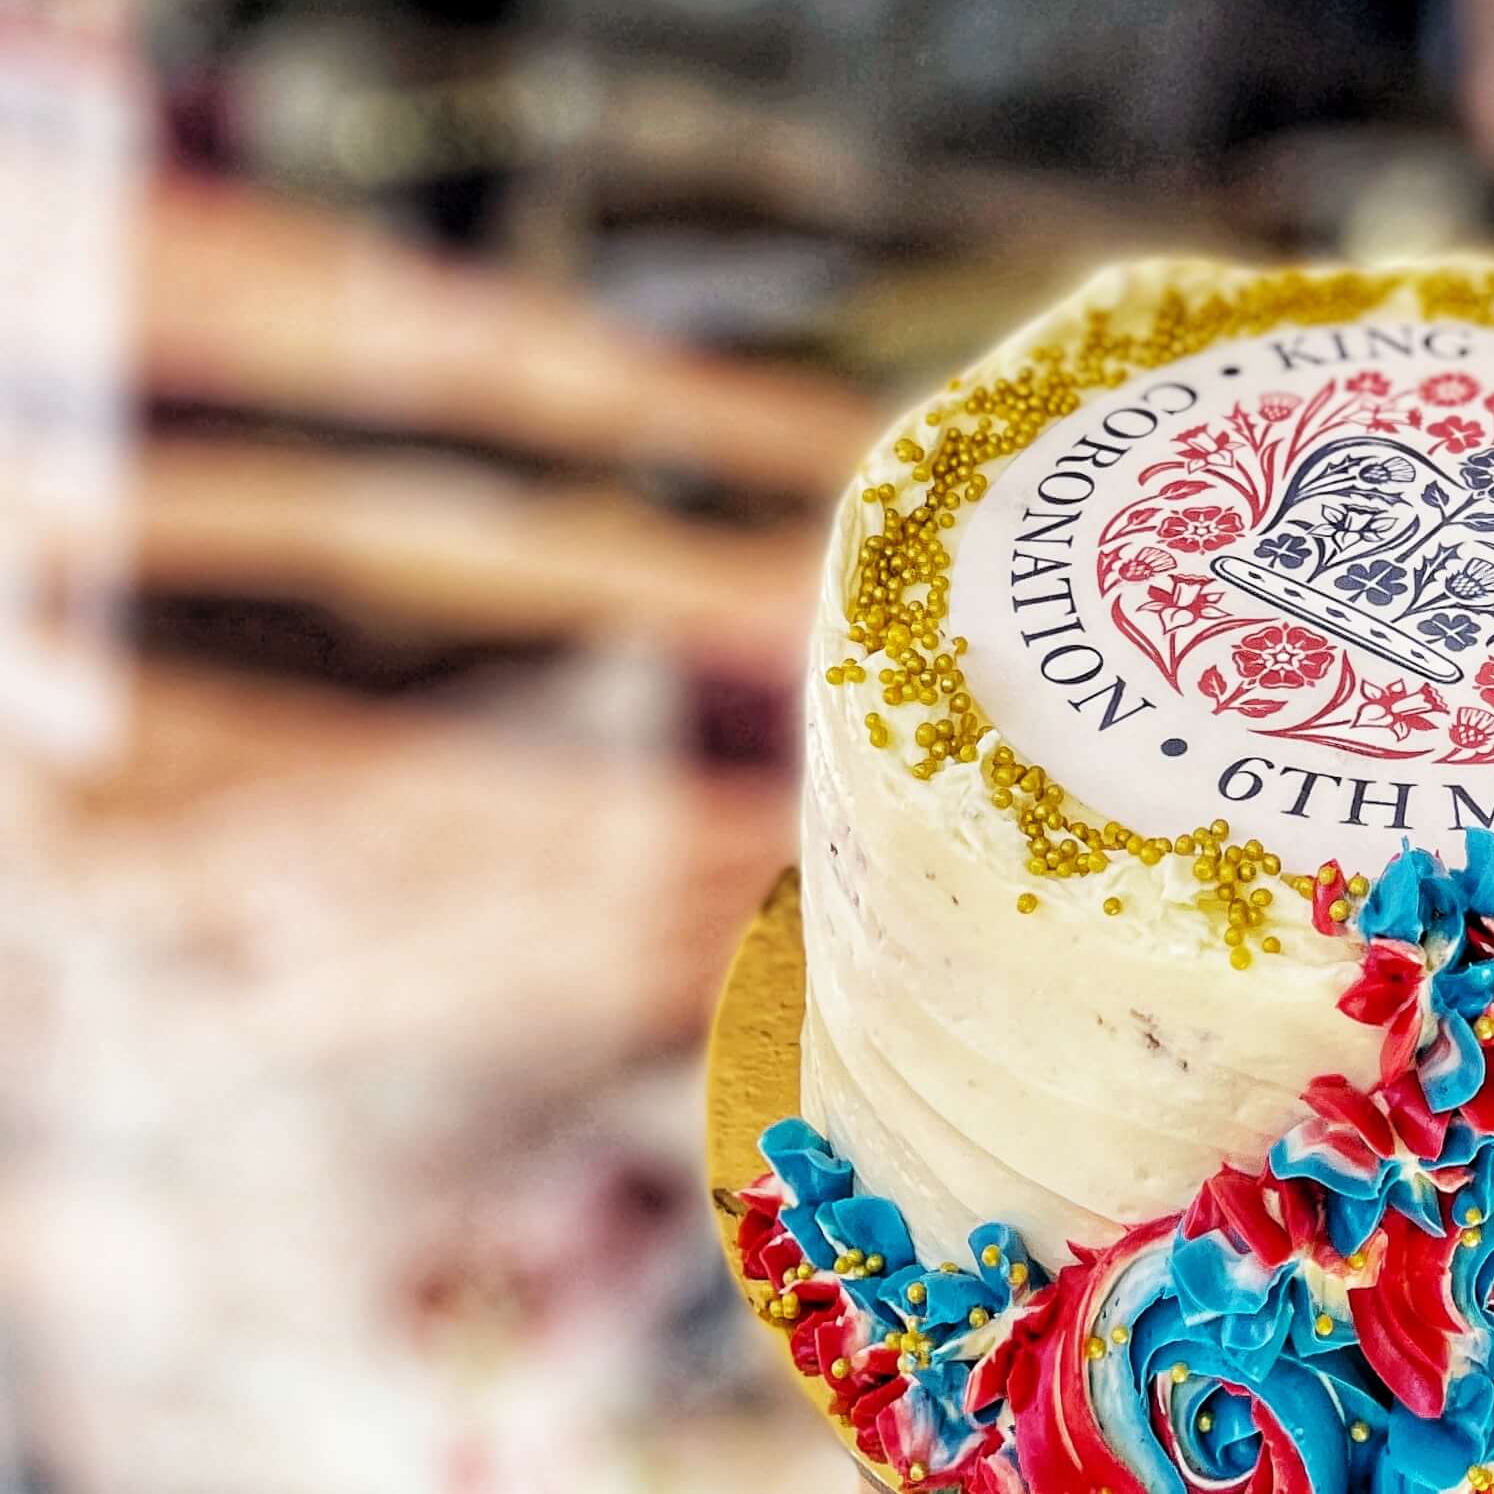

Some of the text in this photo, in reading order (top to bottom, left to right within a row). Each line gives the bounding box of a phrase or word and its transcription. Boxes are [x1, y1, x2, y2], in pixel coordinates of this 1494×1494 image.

[1271, 324, 1475, 373] KING
[1010, 381, 1199, 732] CORONATION
[1217, 756, 1417, 830] 6TH
